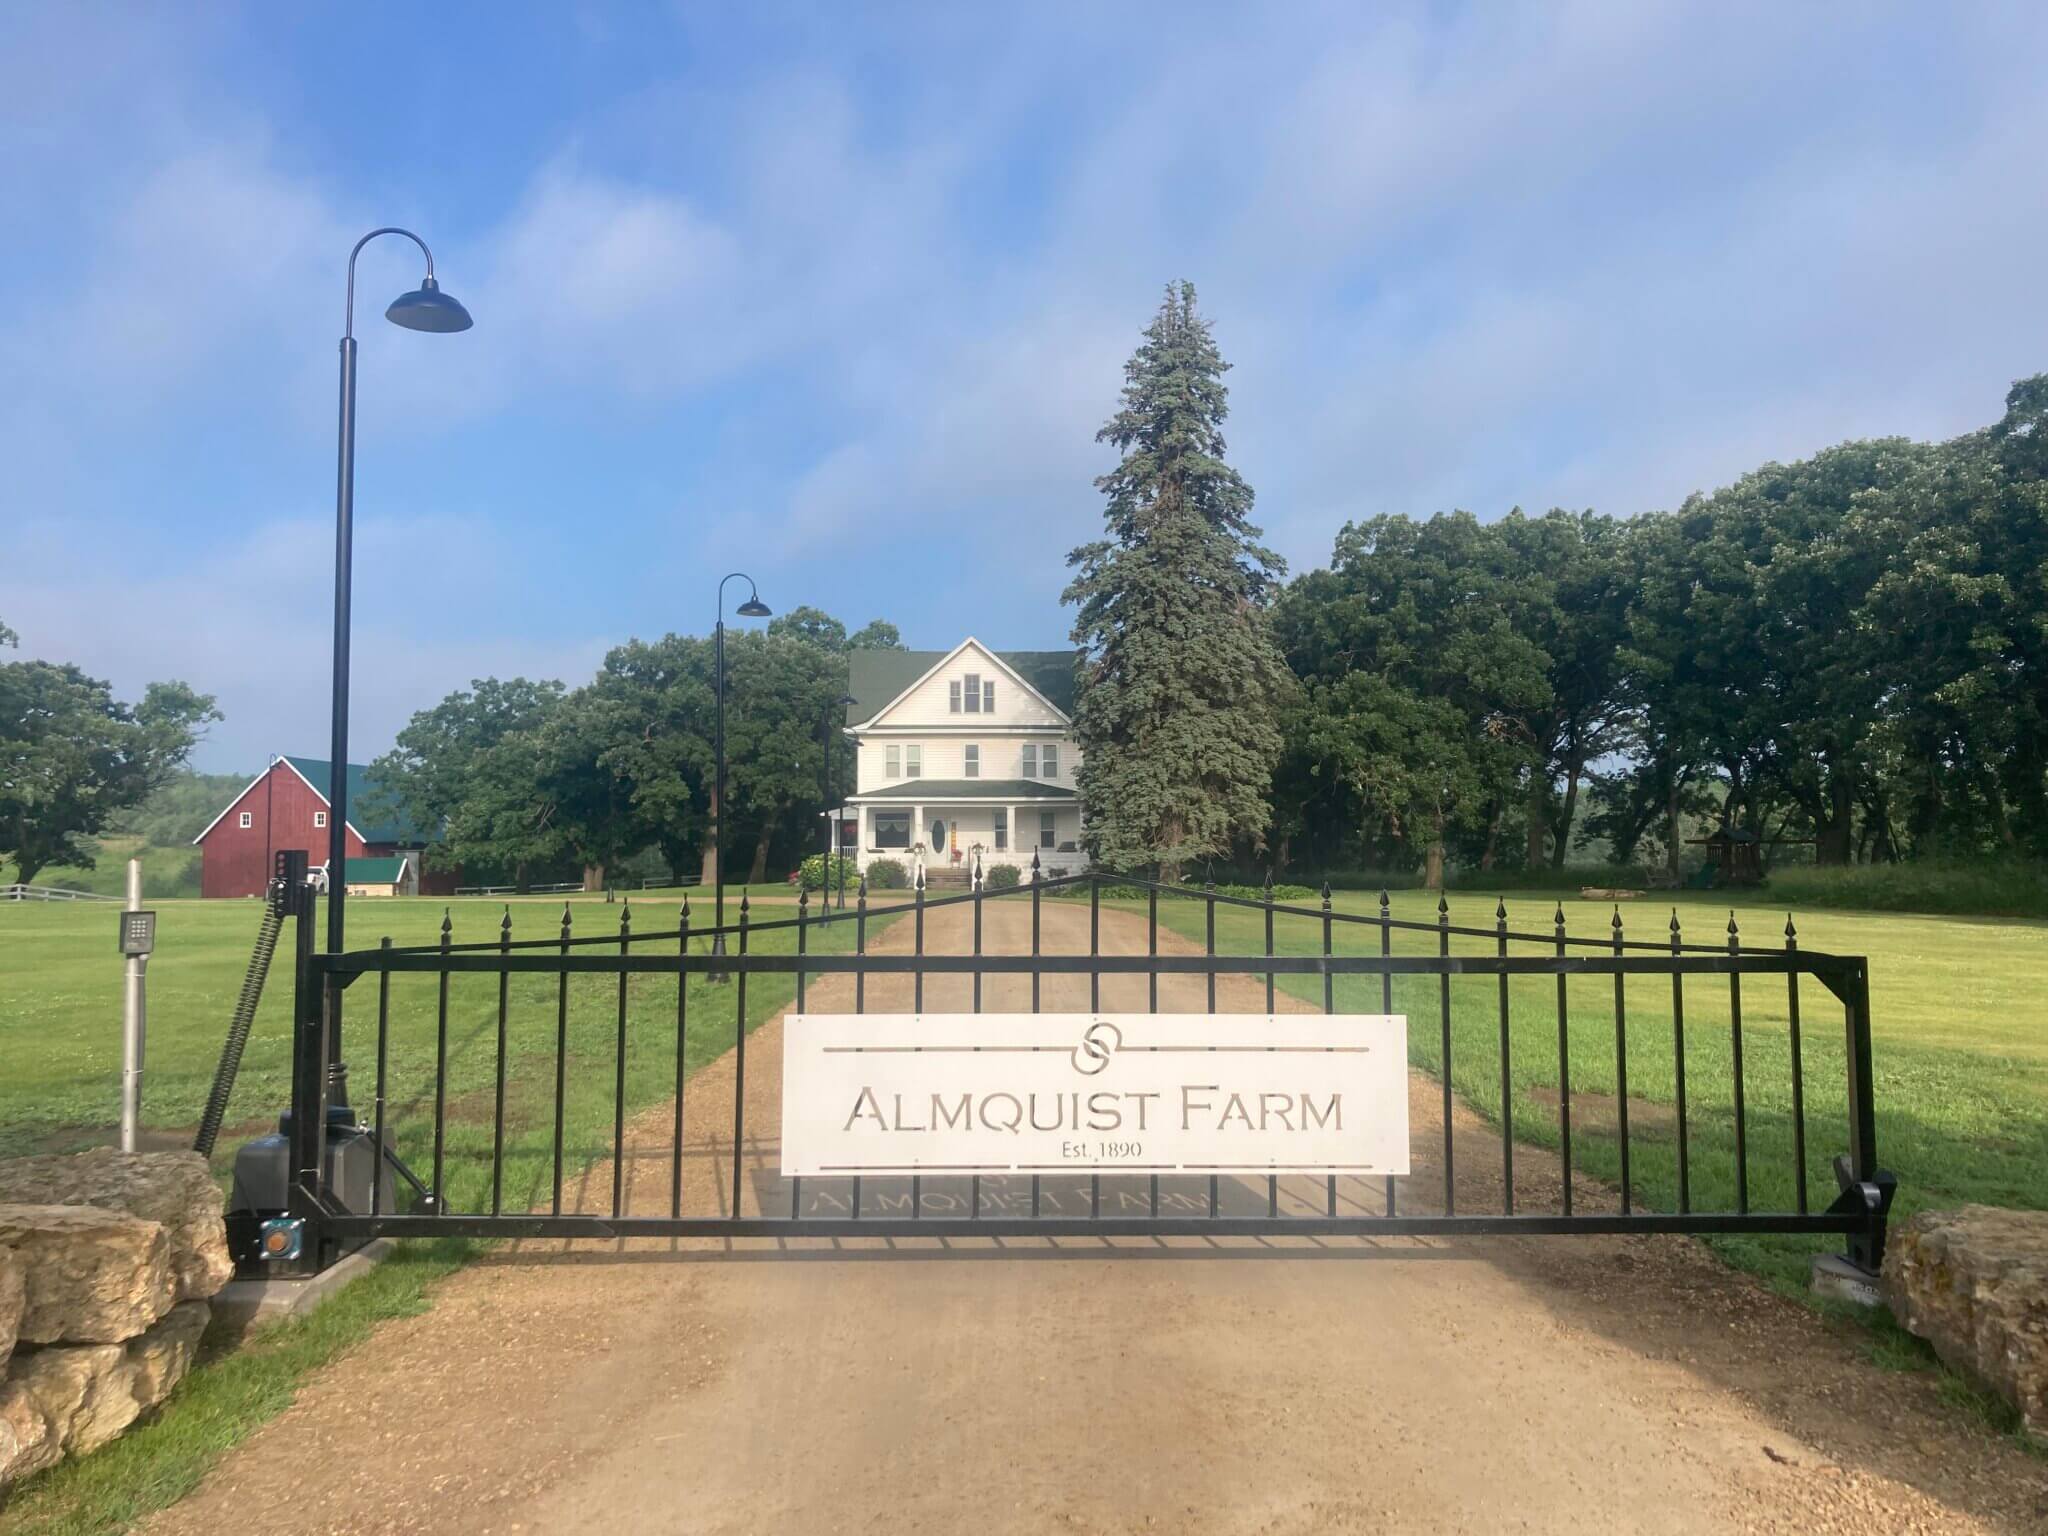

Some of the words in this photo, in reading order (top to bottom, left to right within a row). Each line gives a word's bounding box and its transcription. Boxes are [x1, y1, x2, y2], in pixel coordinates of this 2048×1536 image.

[843, 1086, 1160, 1134] ALMQUIST
[1181, 1085, 1343, 1131] FARM
[1062, 1141, 1092, 1158] Est.
[1099, 1142, 1142, 1158] 1890
